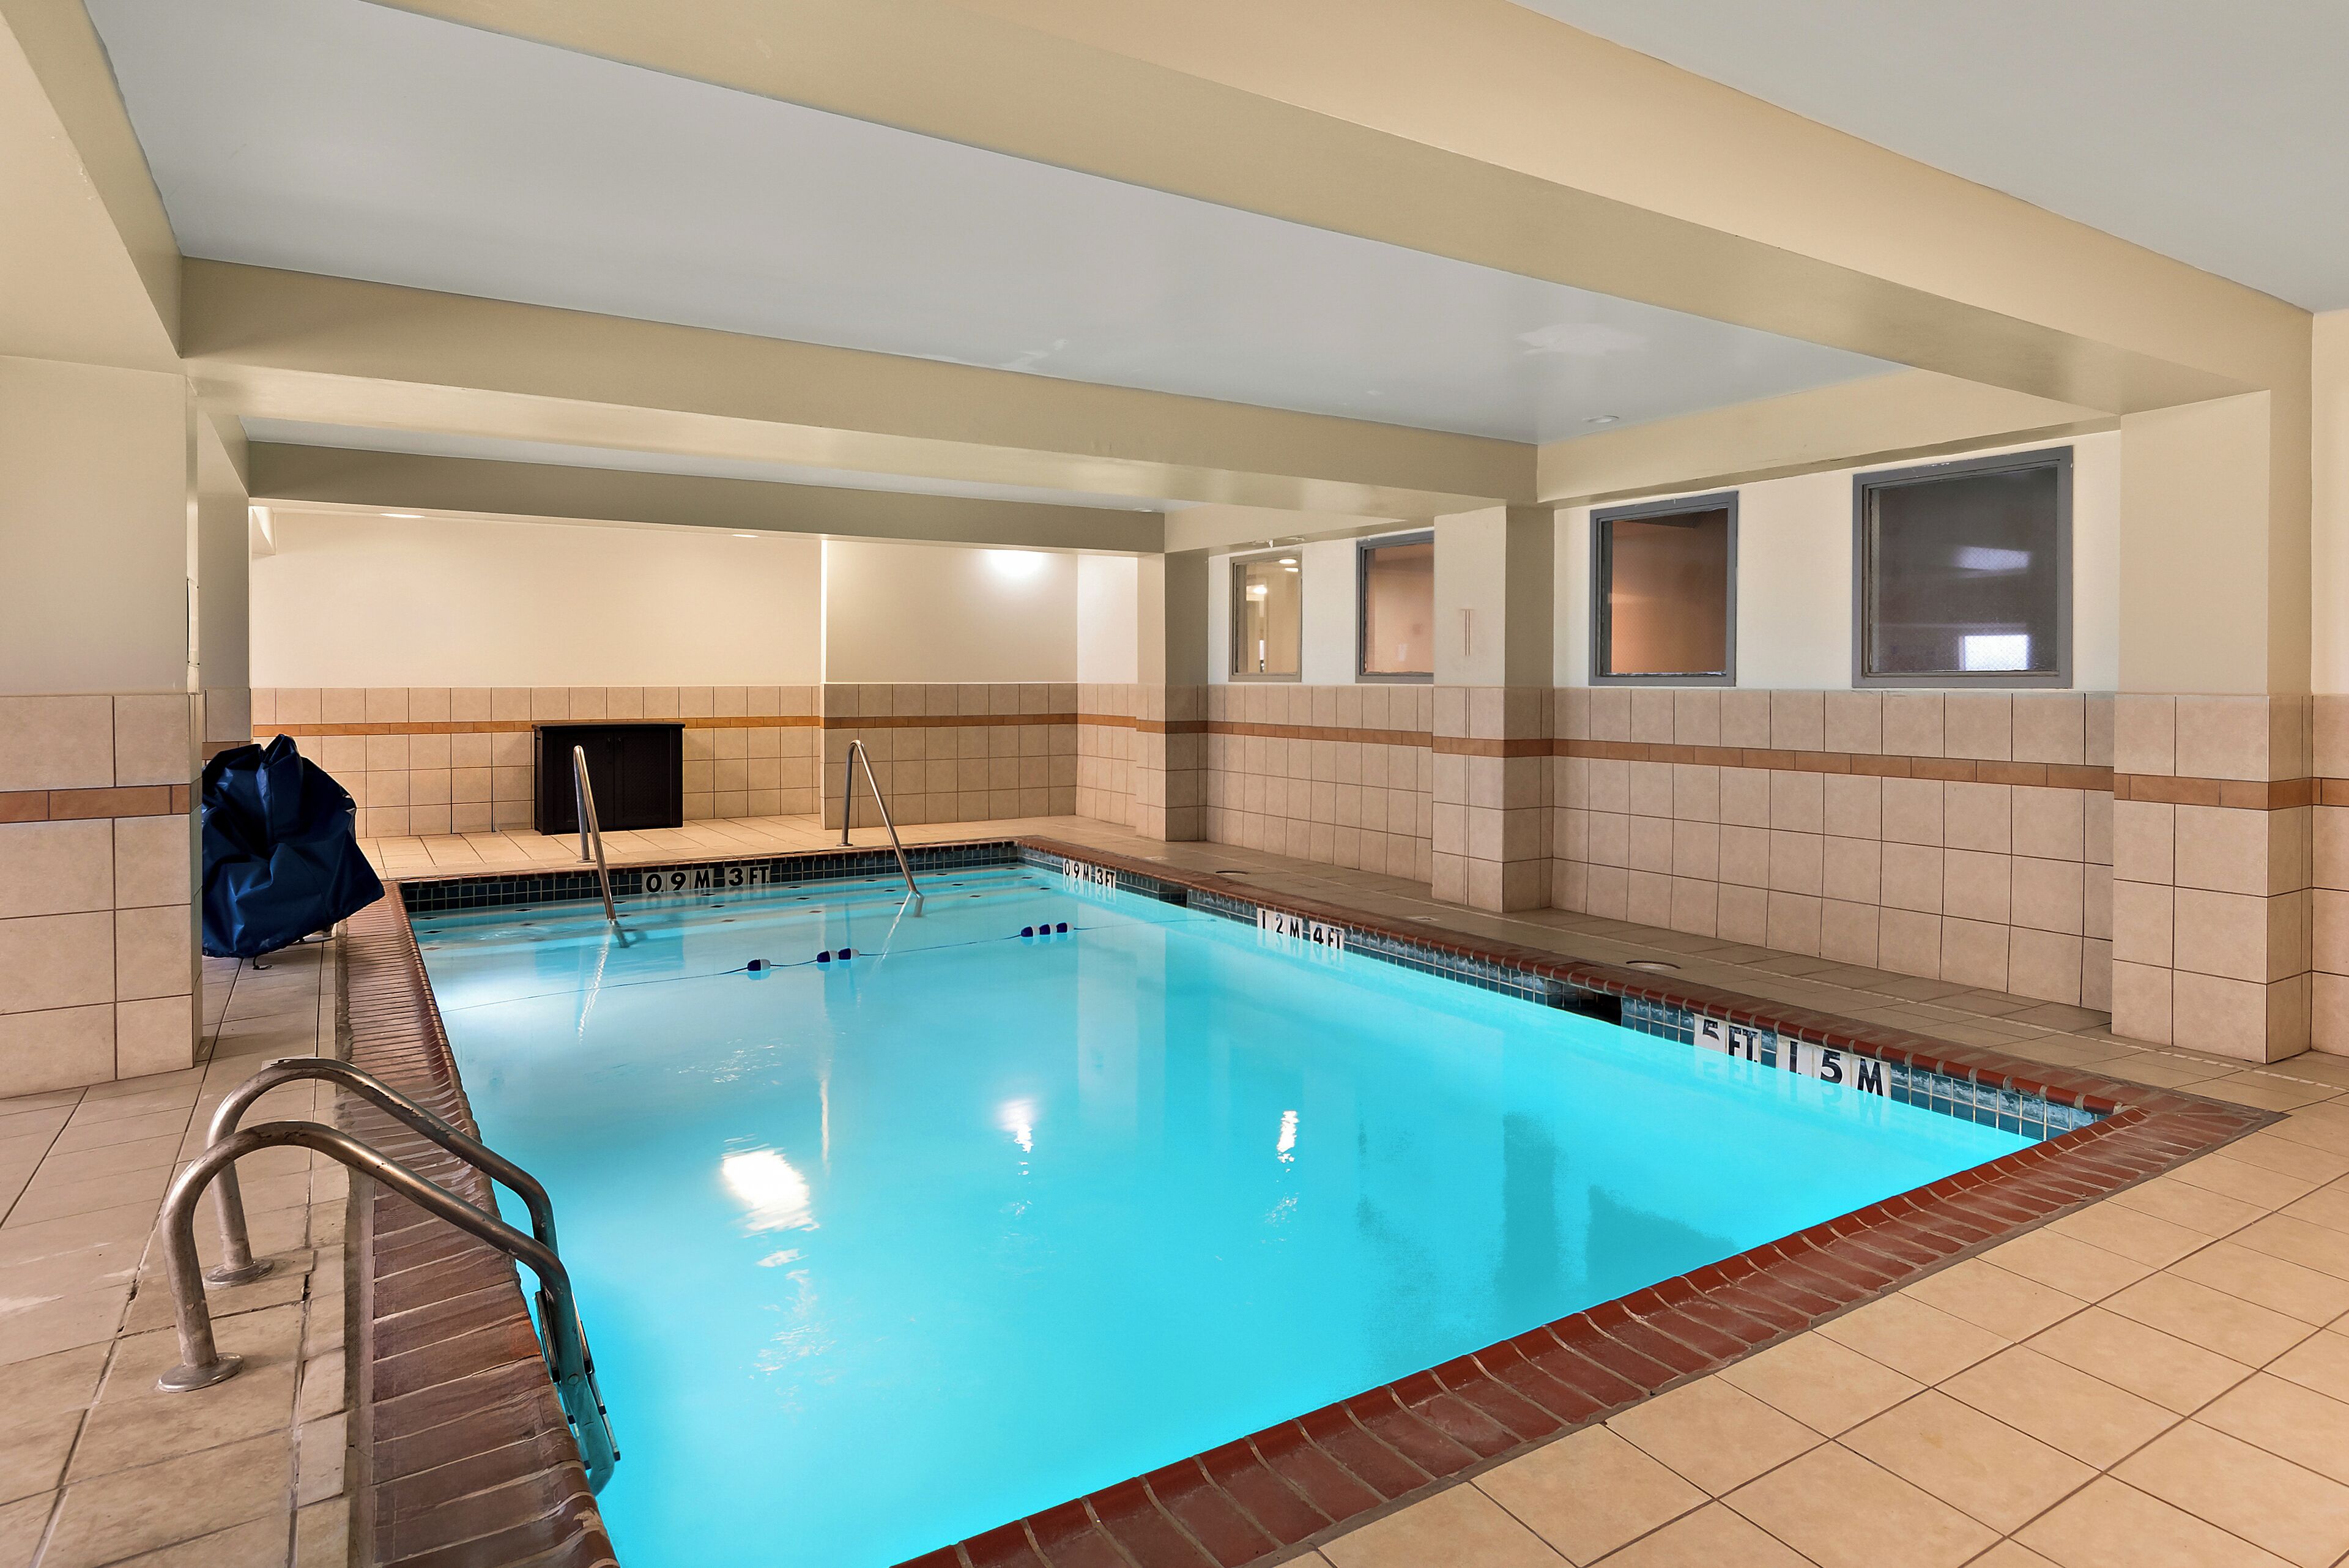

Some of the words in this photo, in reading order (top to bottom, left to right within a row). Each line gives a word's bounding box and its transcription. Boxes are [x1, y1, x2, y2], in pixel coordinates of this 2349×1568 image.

[729, 868, 743, 886] 3
[1097, 868, 1103, 885] 3
[1313, 924, 1324, 944] 4
